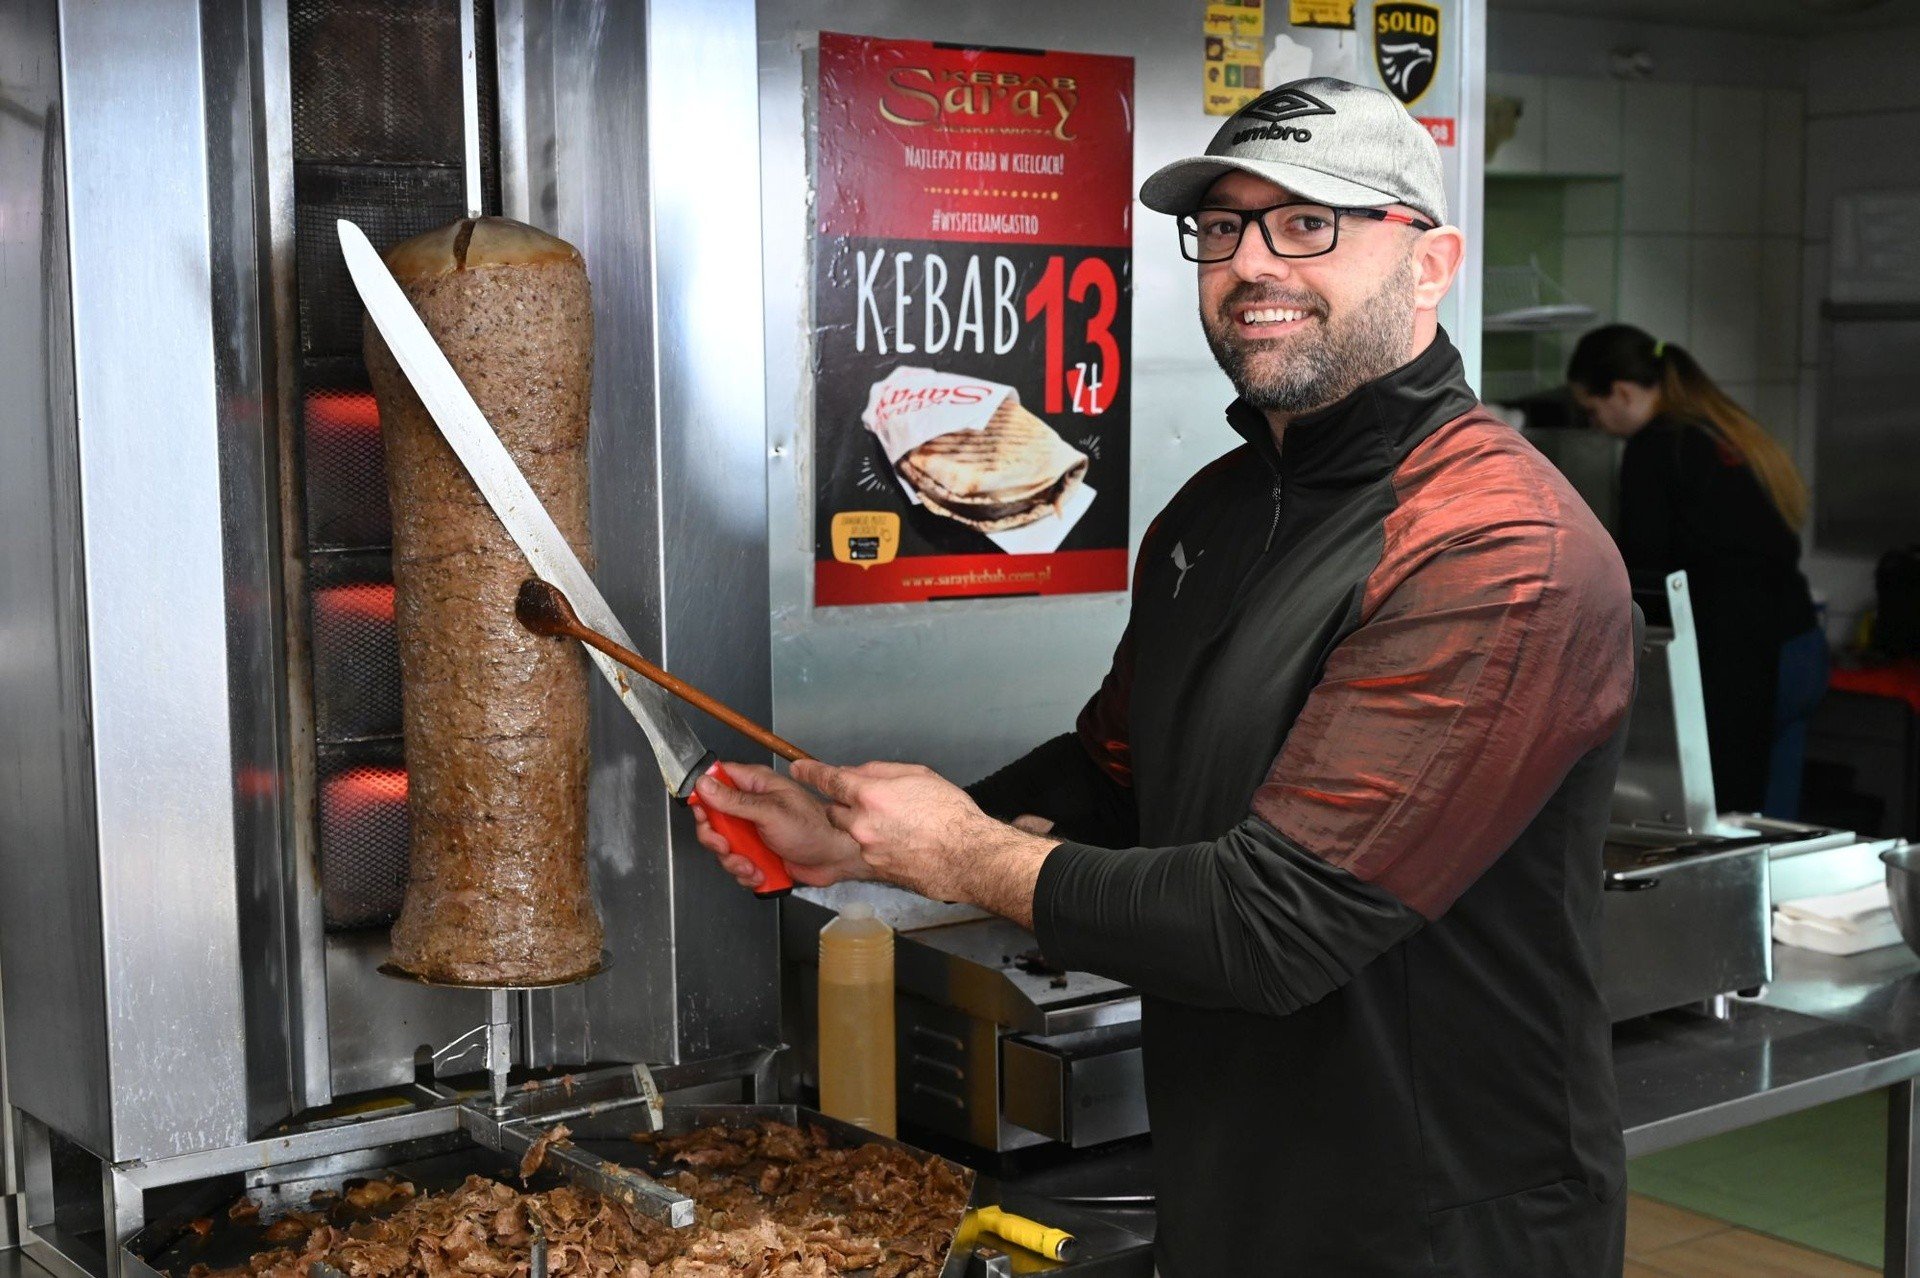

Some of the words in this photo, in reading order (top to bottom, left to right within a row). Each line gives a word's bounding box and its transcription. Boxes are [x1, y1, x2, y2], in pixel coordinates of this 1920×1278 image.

[1379, 11, 1436, 36] SOLID
[940, 69, 1076, 91] KEBAB
[879, 66, 1079, 141] Saray
[1232, 121, 1312, 145] umbro
[965, 150, 997, 172] KEBAB
[1000, 152, 1010, 173] W
[856, 248, 1020, 355] KEBAB
[1025, 257, 1120, 415] 13
